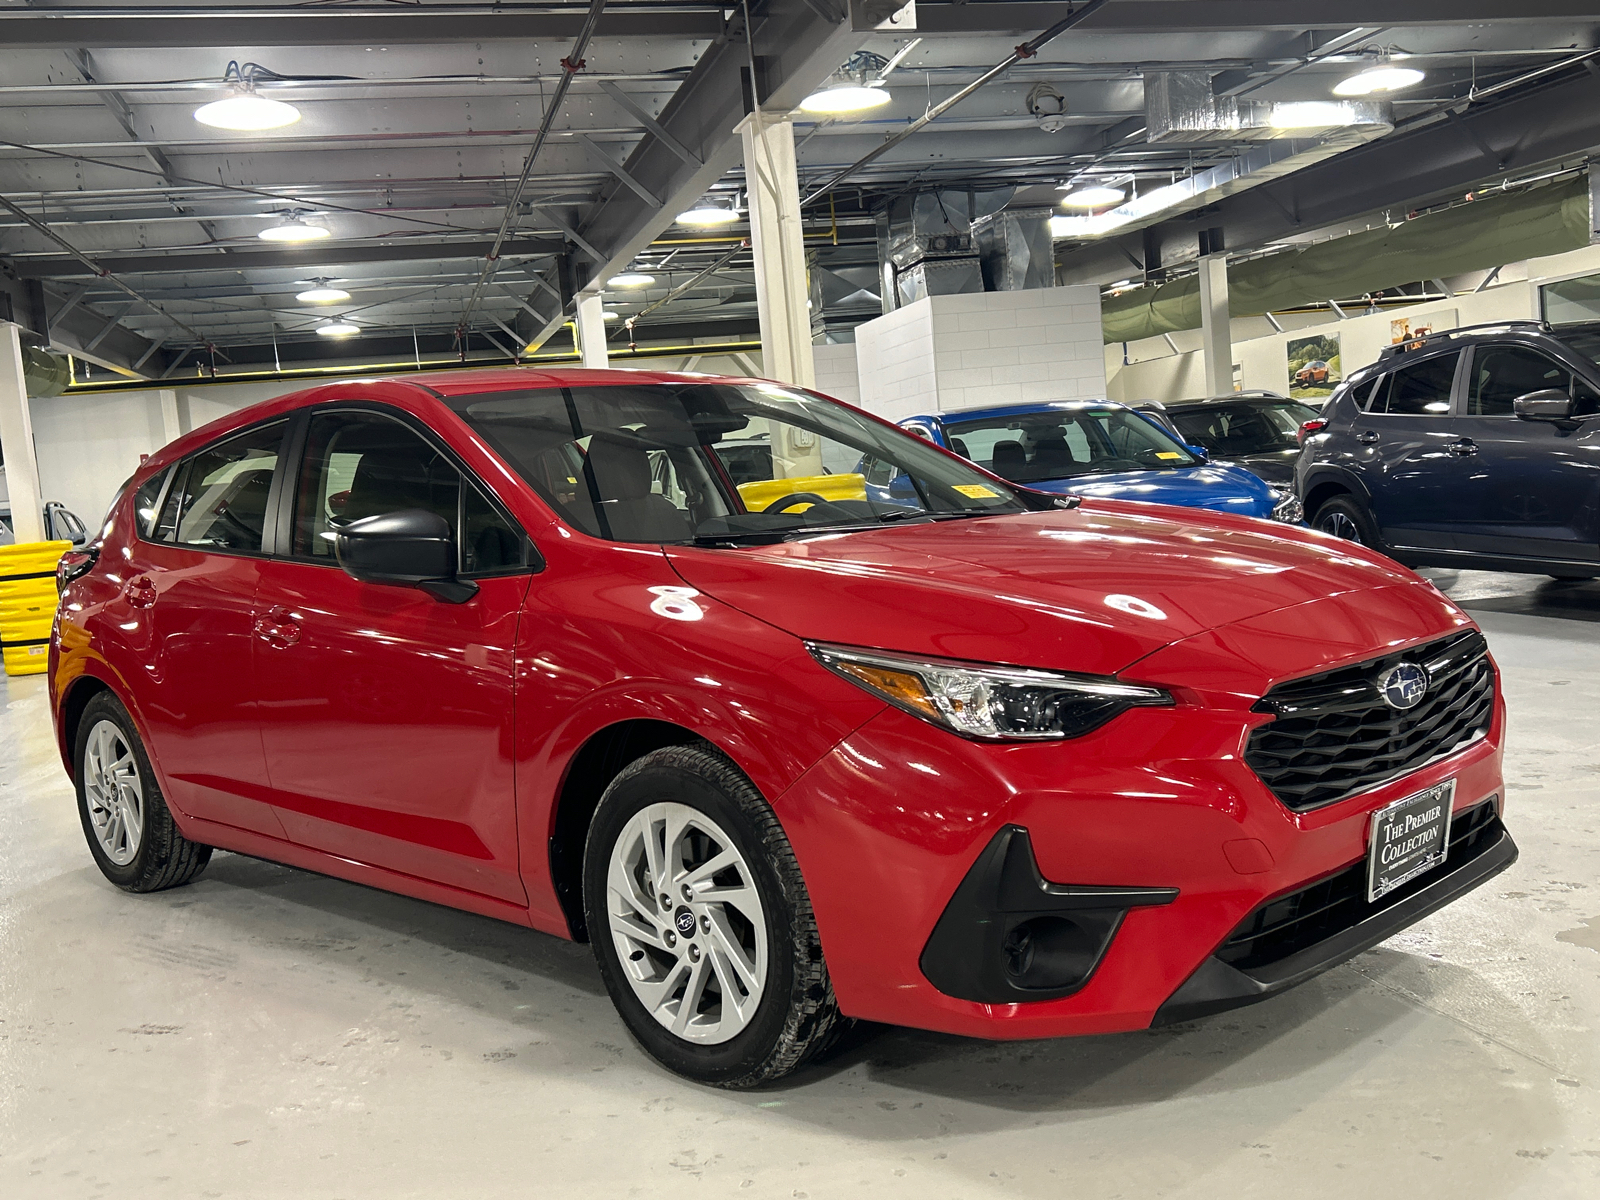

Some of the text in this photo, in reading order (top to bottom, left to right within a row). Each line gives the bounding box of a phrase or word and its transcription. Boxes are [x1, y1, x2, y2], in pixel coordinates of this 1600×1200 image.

[1384, 806, 1441, 843] THE PREMIER
[1381, 825, 1439, 864] COLLECTION
